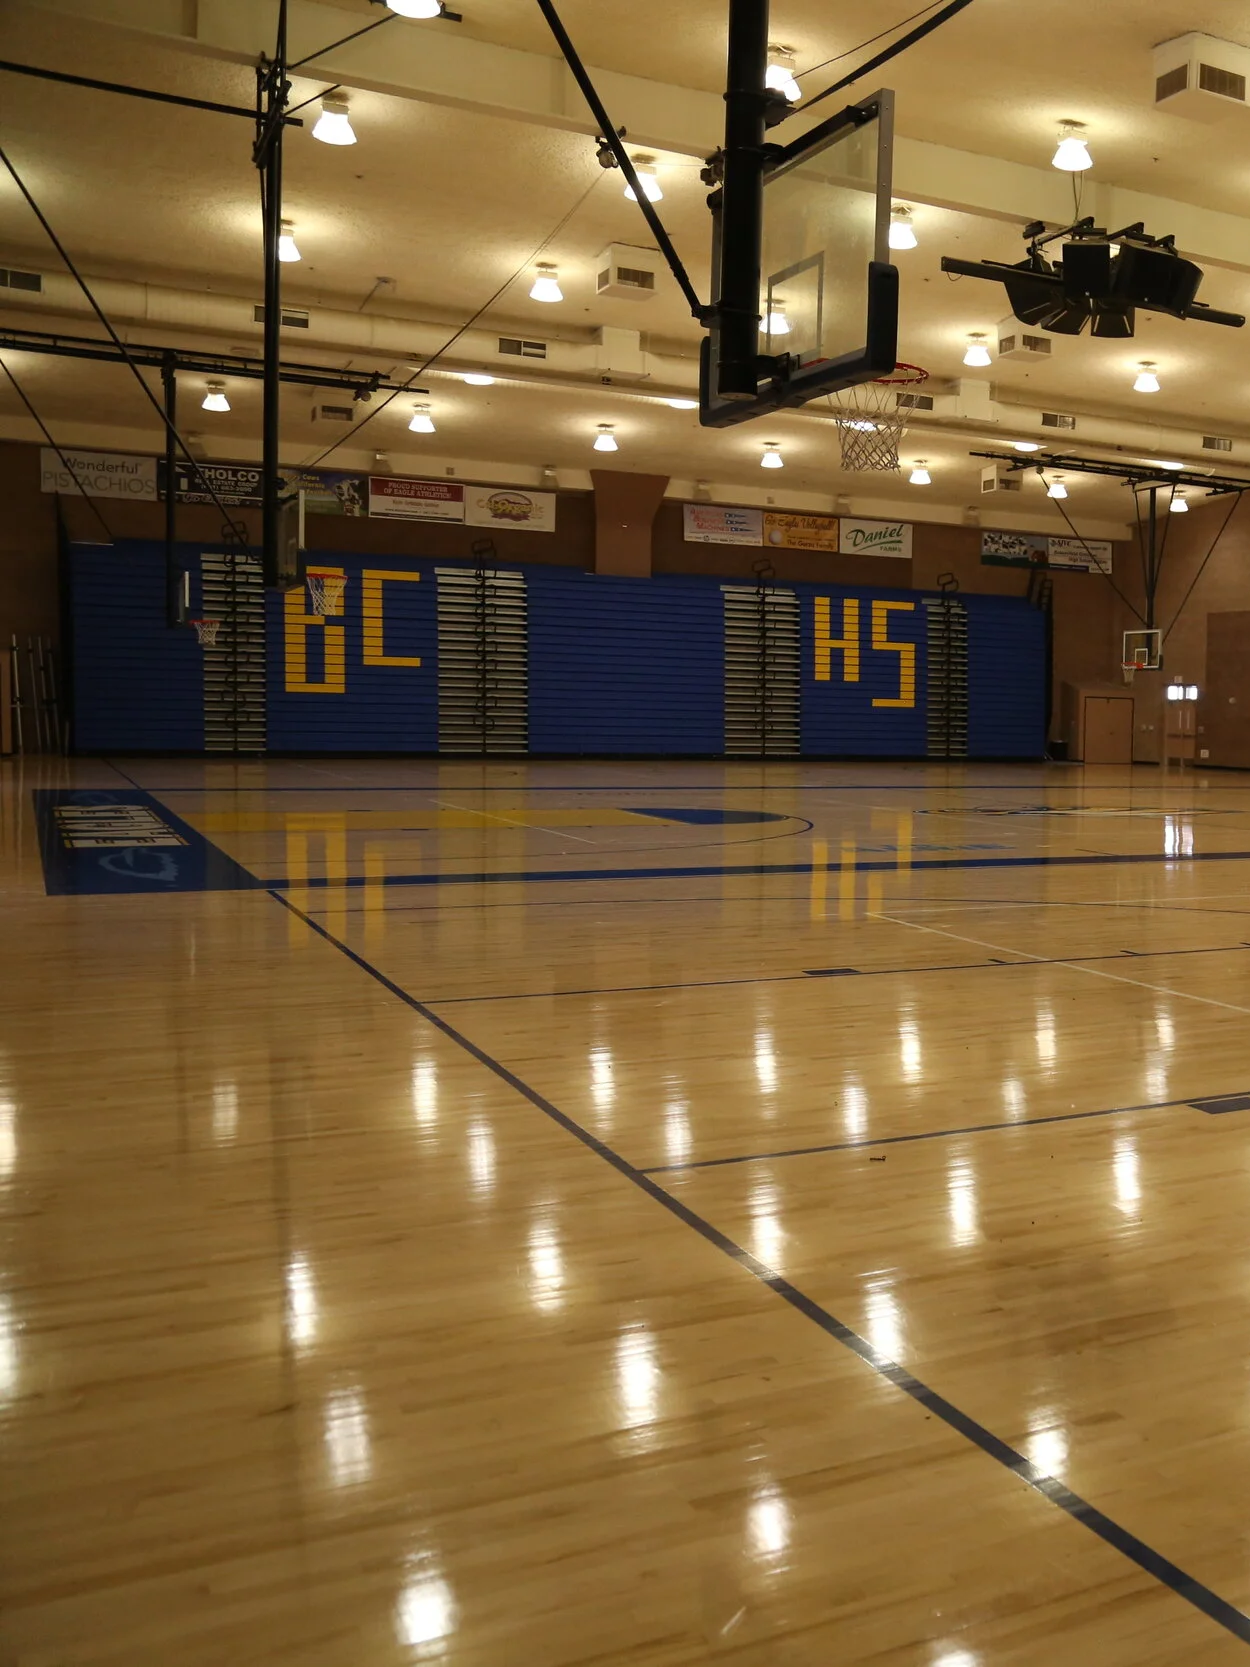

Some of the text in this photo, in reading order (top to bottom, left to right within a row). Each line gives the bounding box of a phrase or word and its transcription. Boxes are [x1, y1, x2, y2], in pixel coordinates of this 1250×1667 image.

[64, 458, 139, 474] Wonderful
[43, 471, 155, 494] PISTACHIOS
[388, 482, 448, 492] PROUD SUPPORTER
[394, 488, 415, 496] EAGLE
[846, 524, 904, 547] Daniel
[814, 596, 915, 708] HS
[51, 804, 192, 848] EAGLES
